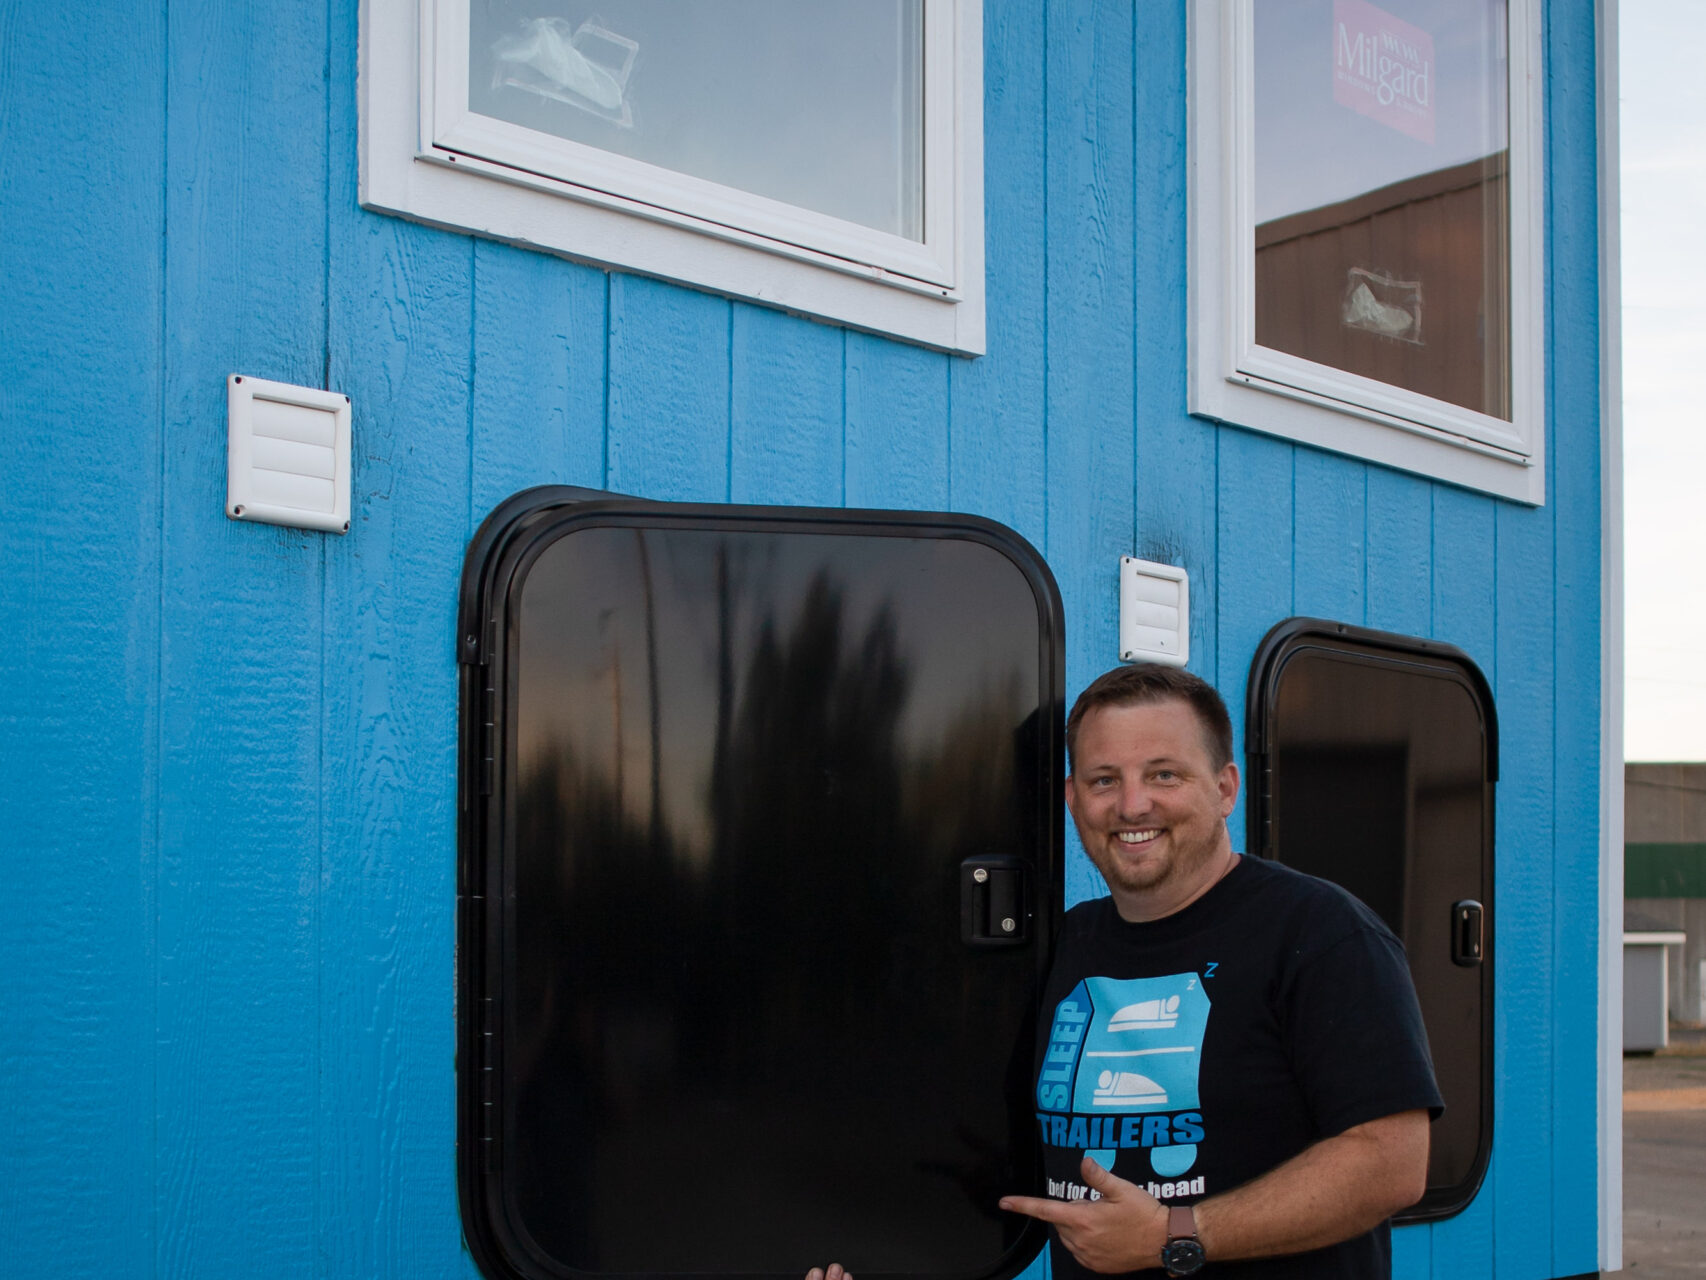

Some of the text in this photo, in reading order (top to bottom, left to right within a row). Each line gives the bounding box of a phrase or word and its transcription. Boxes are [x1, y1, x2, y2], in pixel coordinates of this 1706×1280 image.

[1337, 21, 1429, 107] Milgard
[1041, 1001, 1088, 1110] SLEEP
[1035, 1112, 1206, 1149] TRAILERS
[1048, 1178, 1066, 1197] bed
[1067, 1182, 1088, 1200] for
[1148, 1176, 1205, 1199] head
